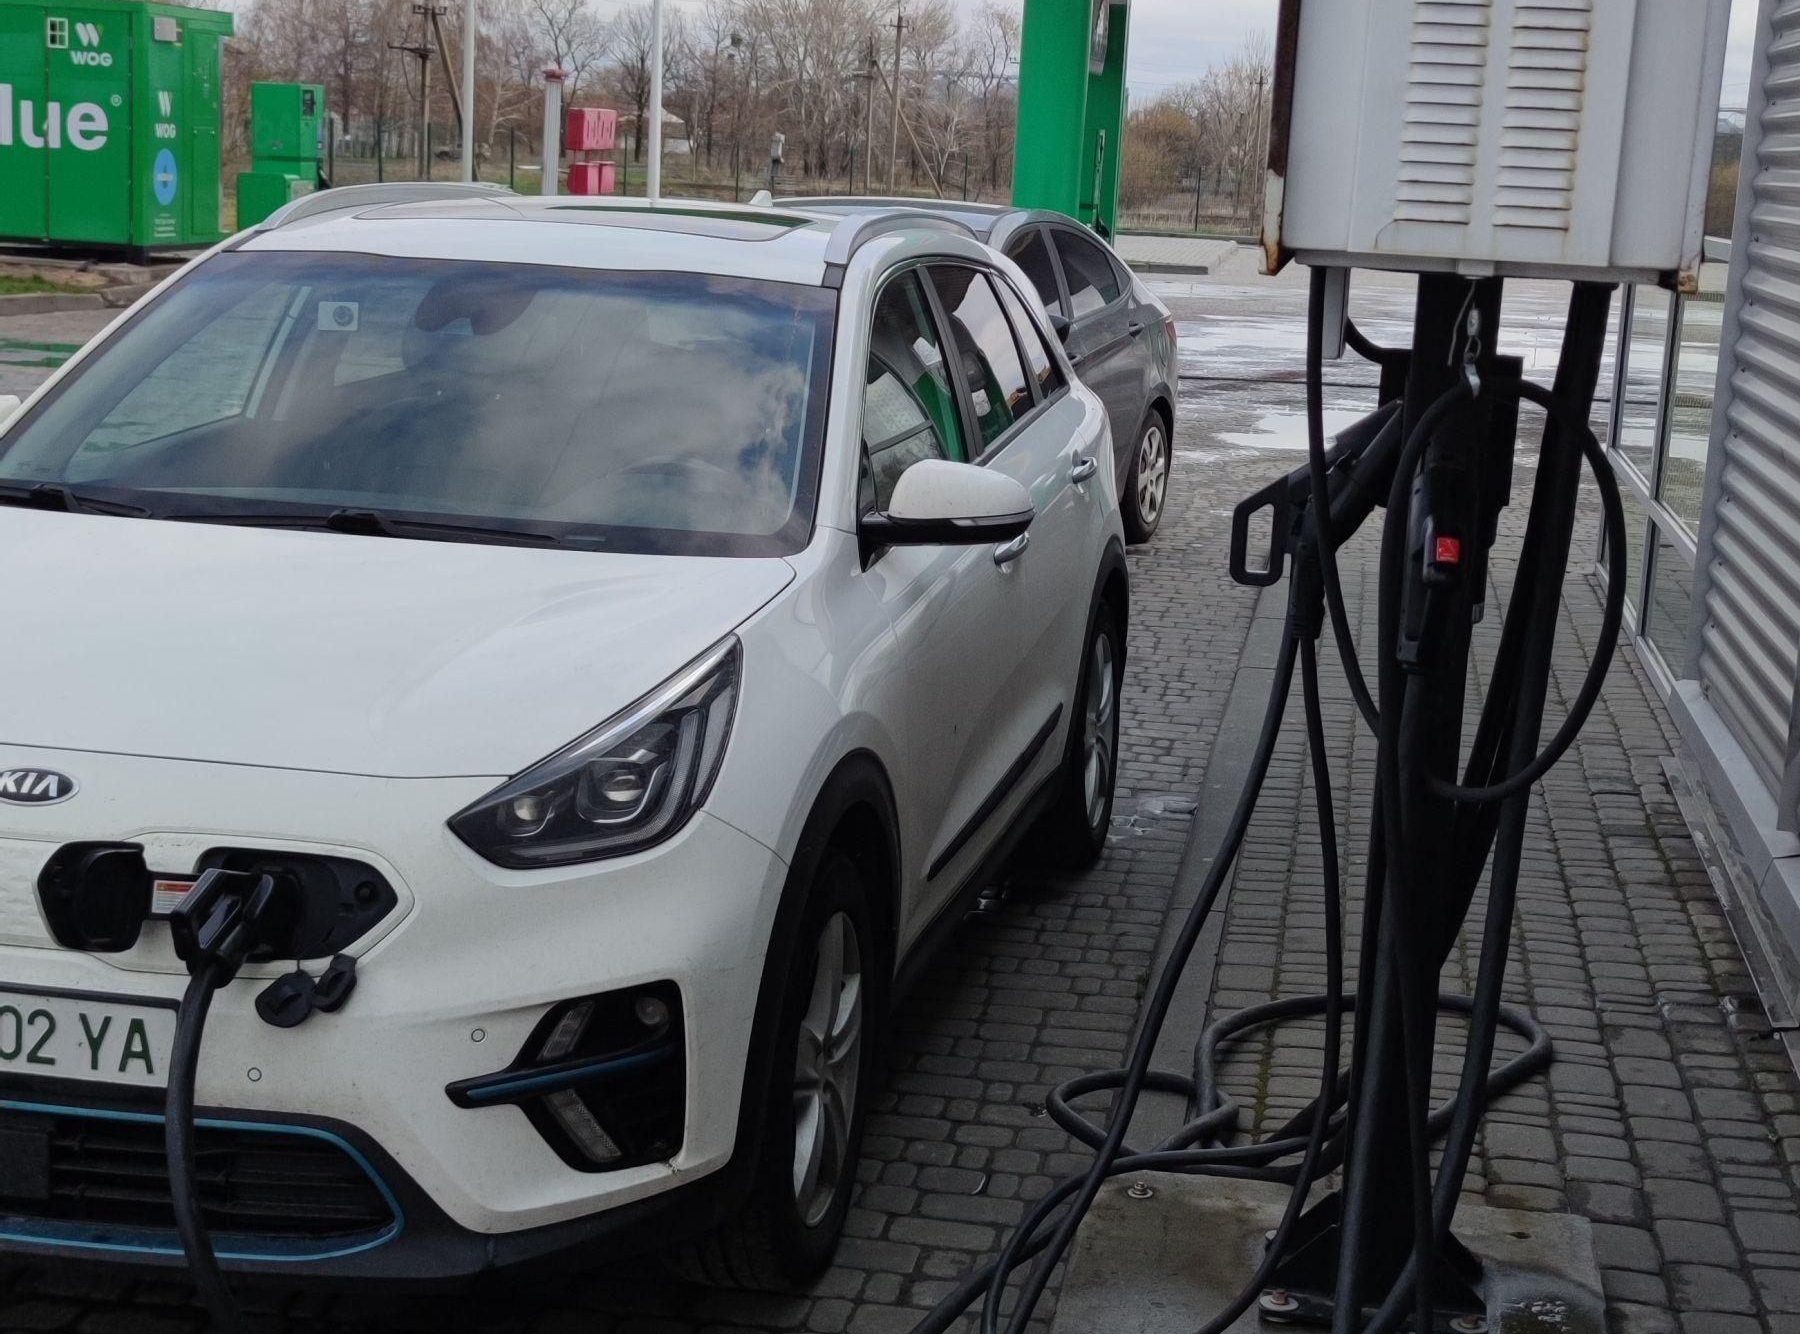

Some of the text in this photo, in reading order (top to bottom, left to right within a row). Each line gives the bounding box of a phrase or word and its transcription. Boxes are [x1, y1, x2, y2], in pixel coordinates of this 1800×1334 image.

[70, 50, 113, 67] WOG
[155, 122, 177, 139] WOG
[0, 771, 59, 798] KIA
[78, 1012, 155, 1075] YA
